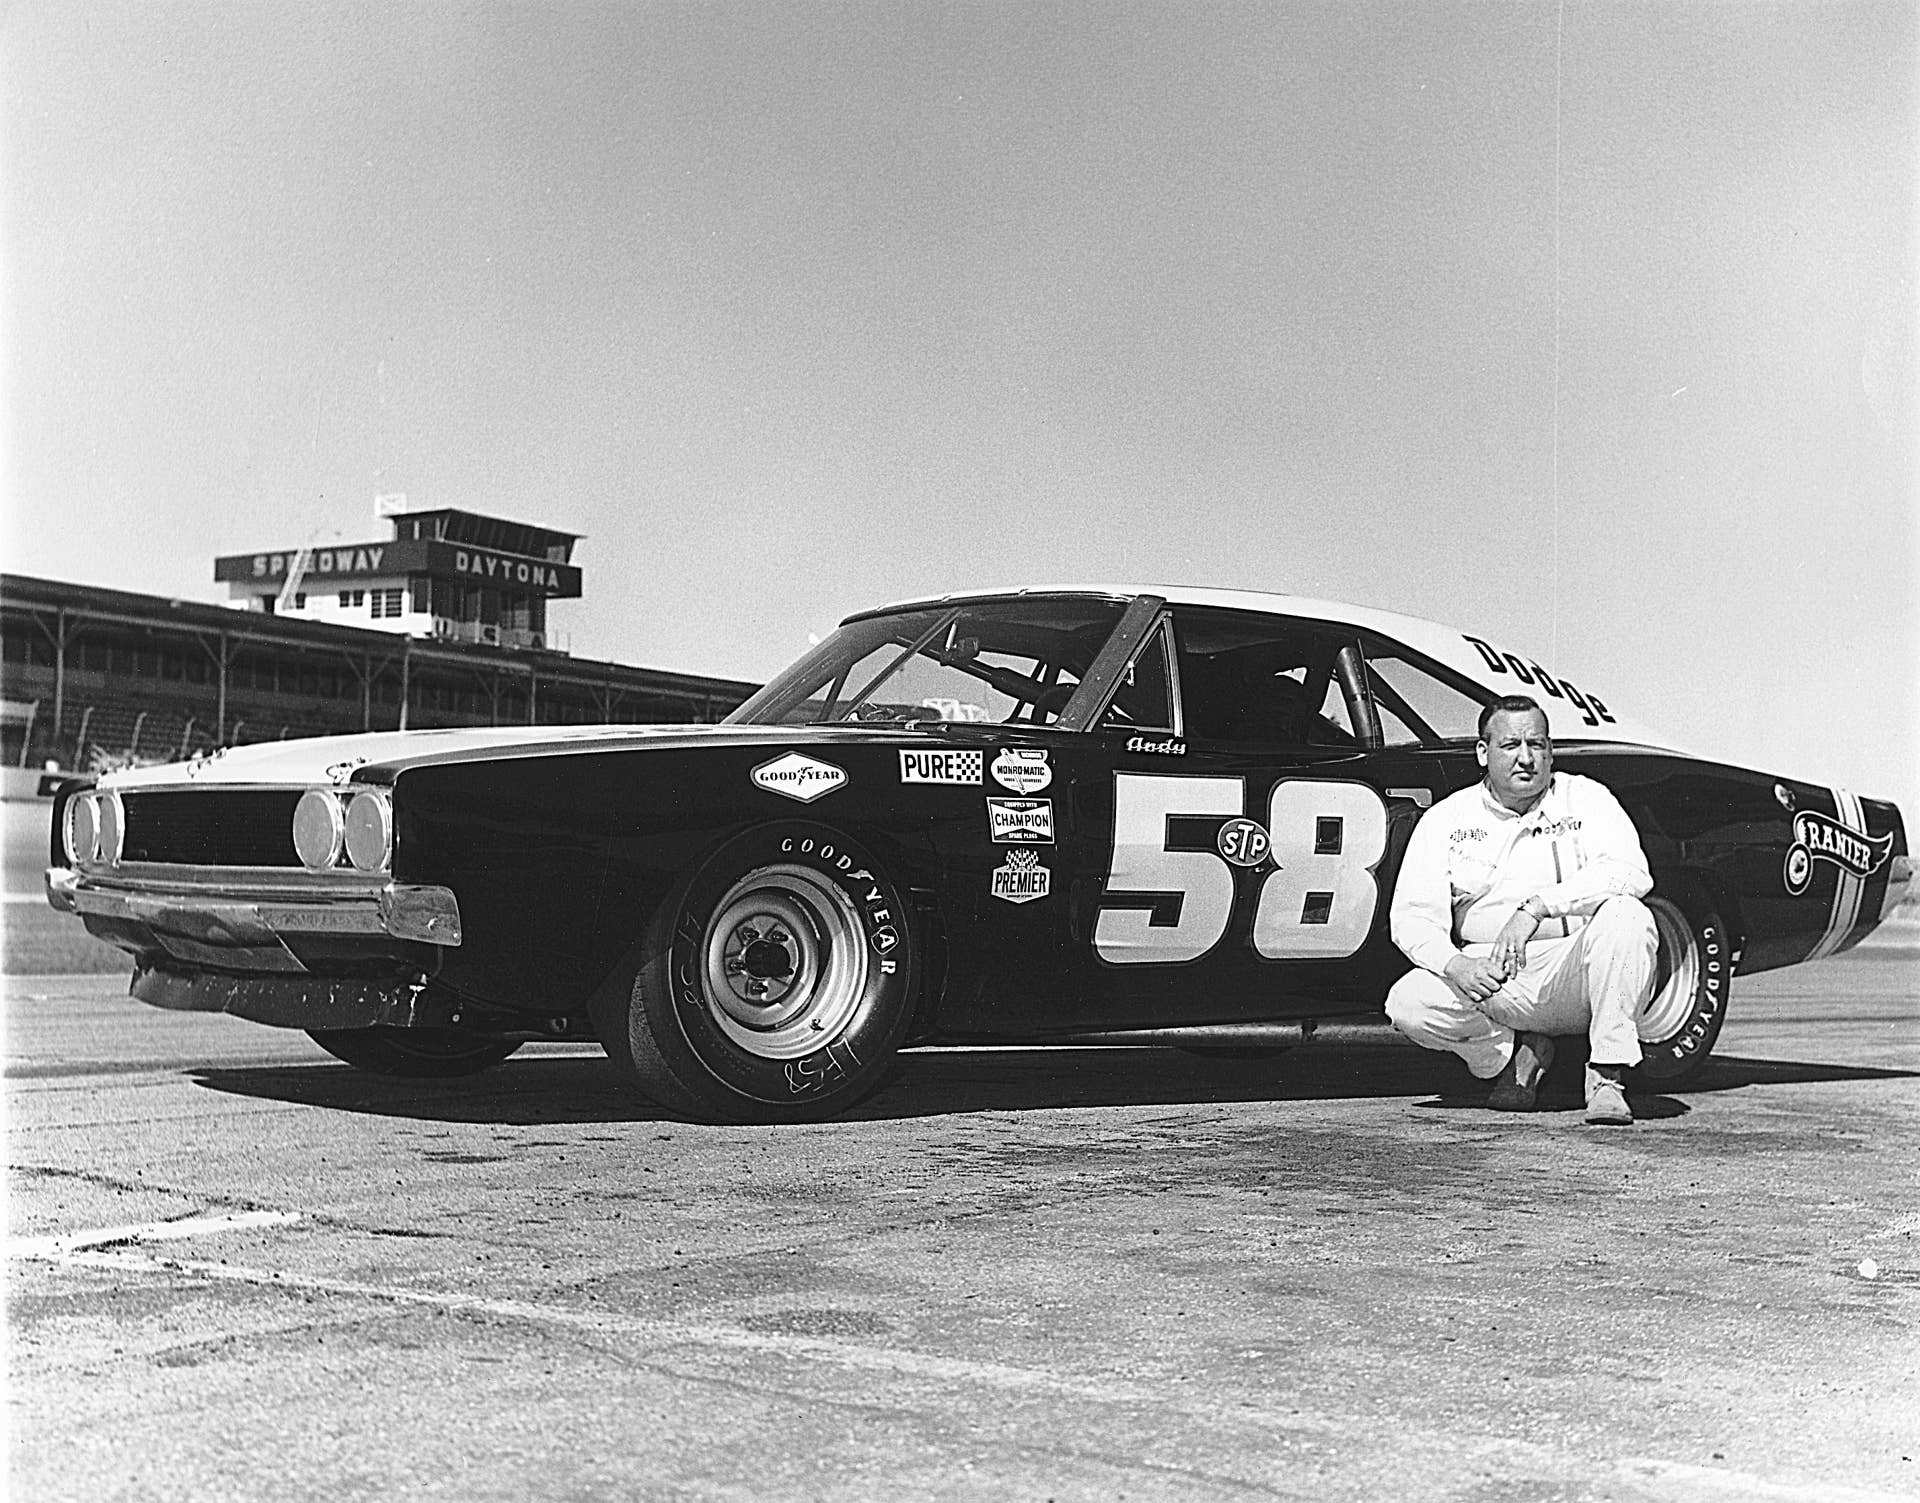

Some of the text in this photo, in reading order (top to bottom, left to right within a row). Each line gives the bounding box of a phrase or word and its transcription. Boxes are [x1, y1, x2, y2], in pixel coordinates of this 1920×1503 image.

[456, 551, 559, 589] DAYTONA
[1461, 634, 1616, 726] Dodge
[1126, 736, 1186, 755] Andy
[904, 752, 954, 779] PURE
[994, 813, 1049, 828] CHAMPION
[1223, 823, 1266, 860] STP
[1806, 821, 1871, 871] RANIER
[995, 871, 1047, 893] PREMIER
[1094, 773, 1387, 964] 58
